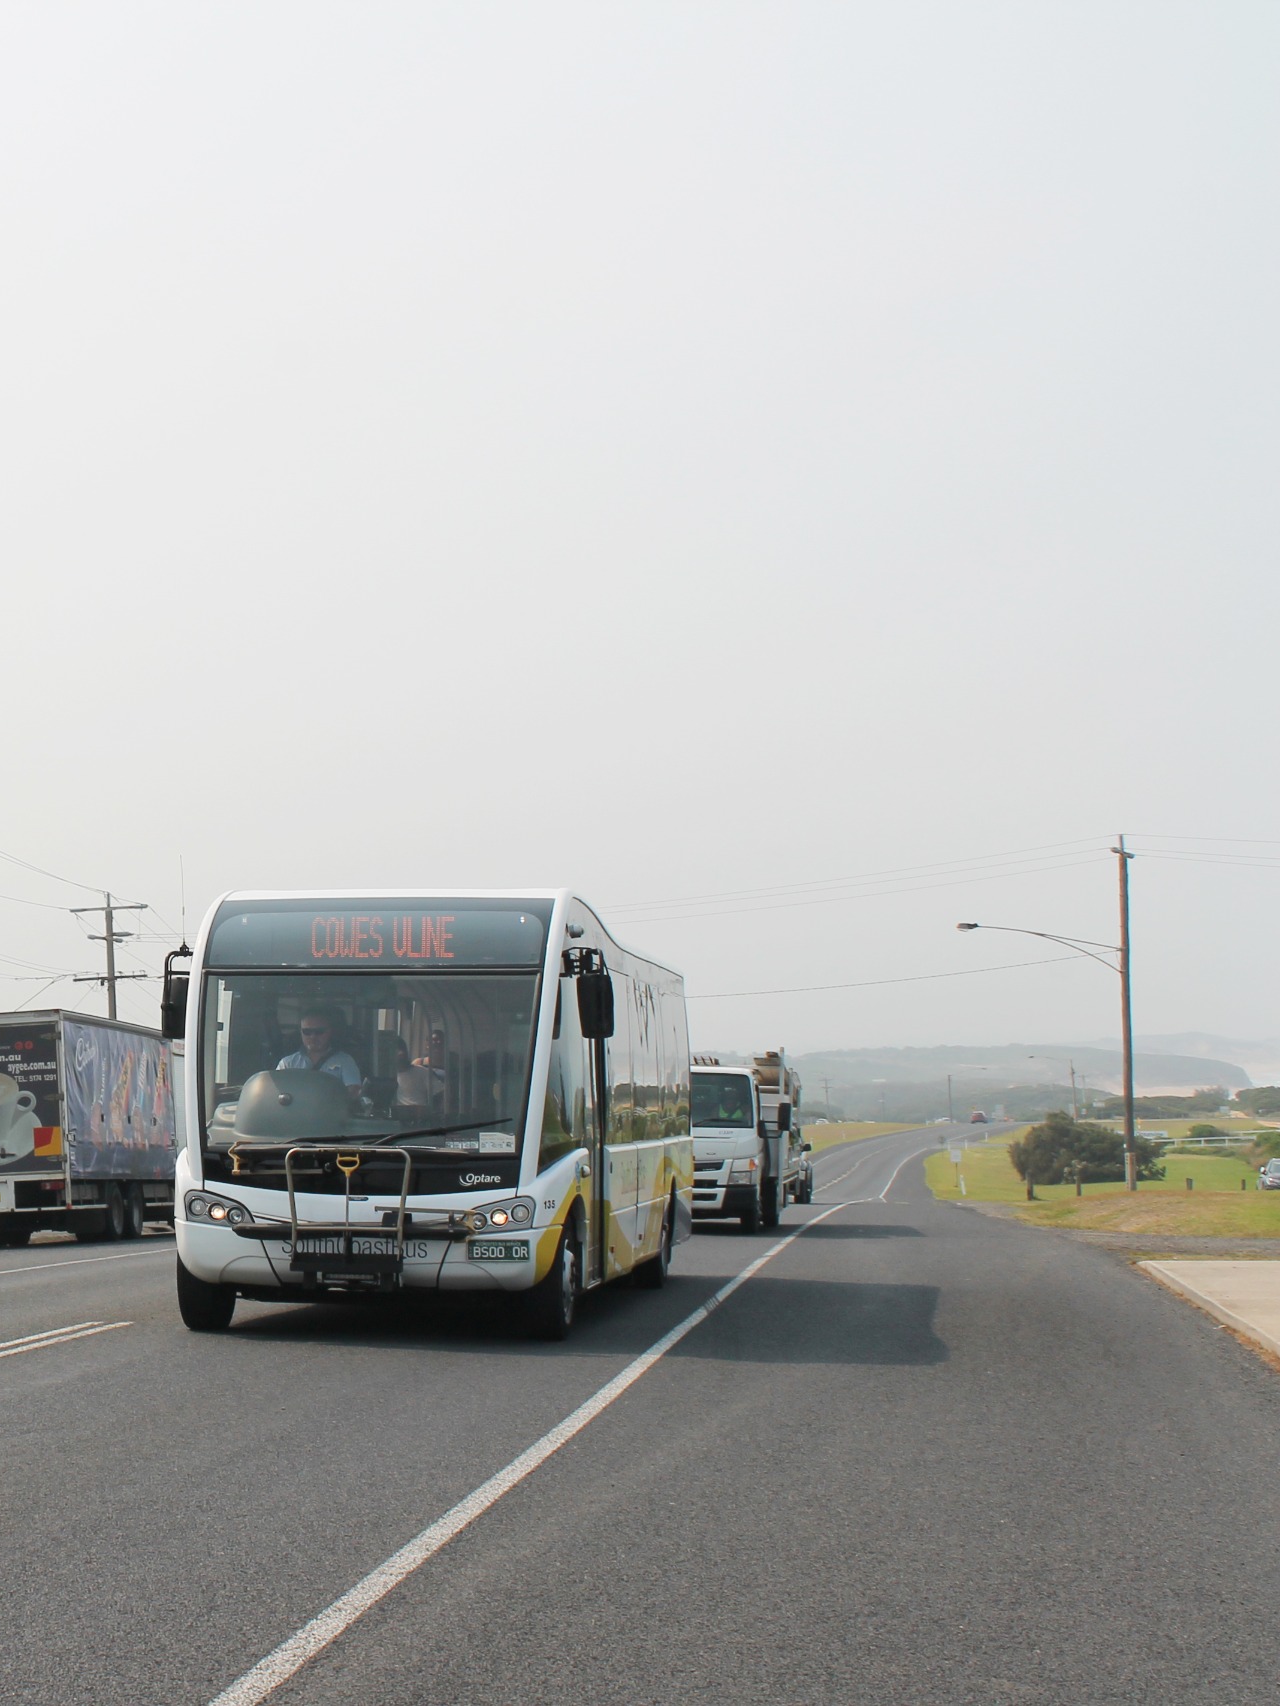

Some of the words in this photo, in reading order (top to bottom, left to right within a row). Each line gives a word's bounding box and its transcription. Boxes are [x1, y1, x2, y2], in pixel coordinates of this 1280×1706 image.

[311, 916, 383, 958] COWES
[392, 916, 455, 958] VLINE
[7, 1061, 57, 1075] aygee.com.au
[43, 1073, 57, 1081] 1291
[465, 1173, 502, 1185] Optare
[543, 1200, 556, 1210] 135
